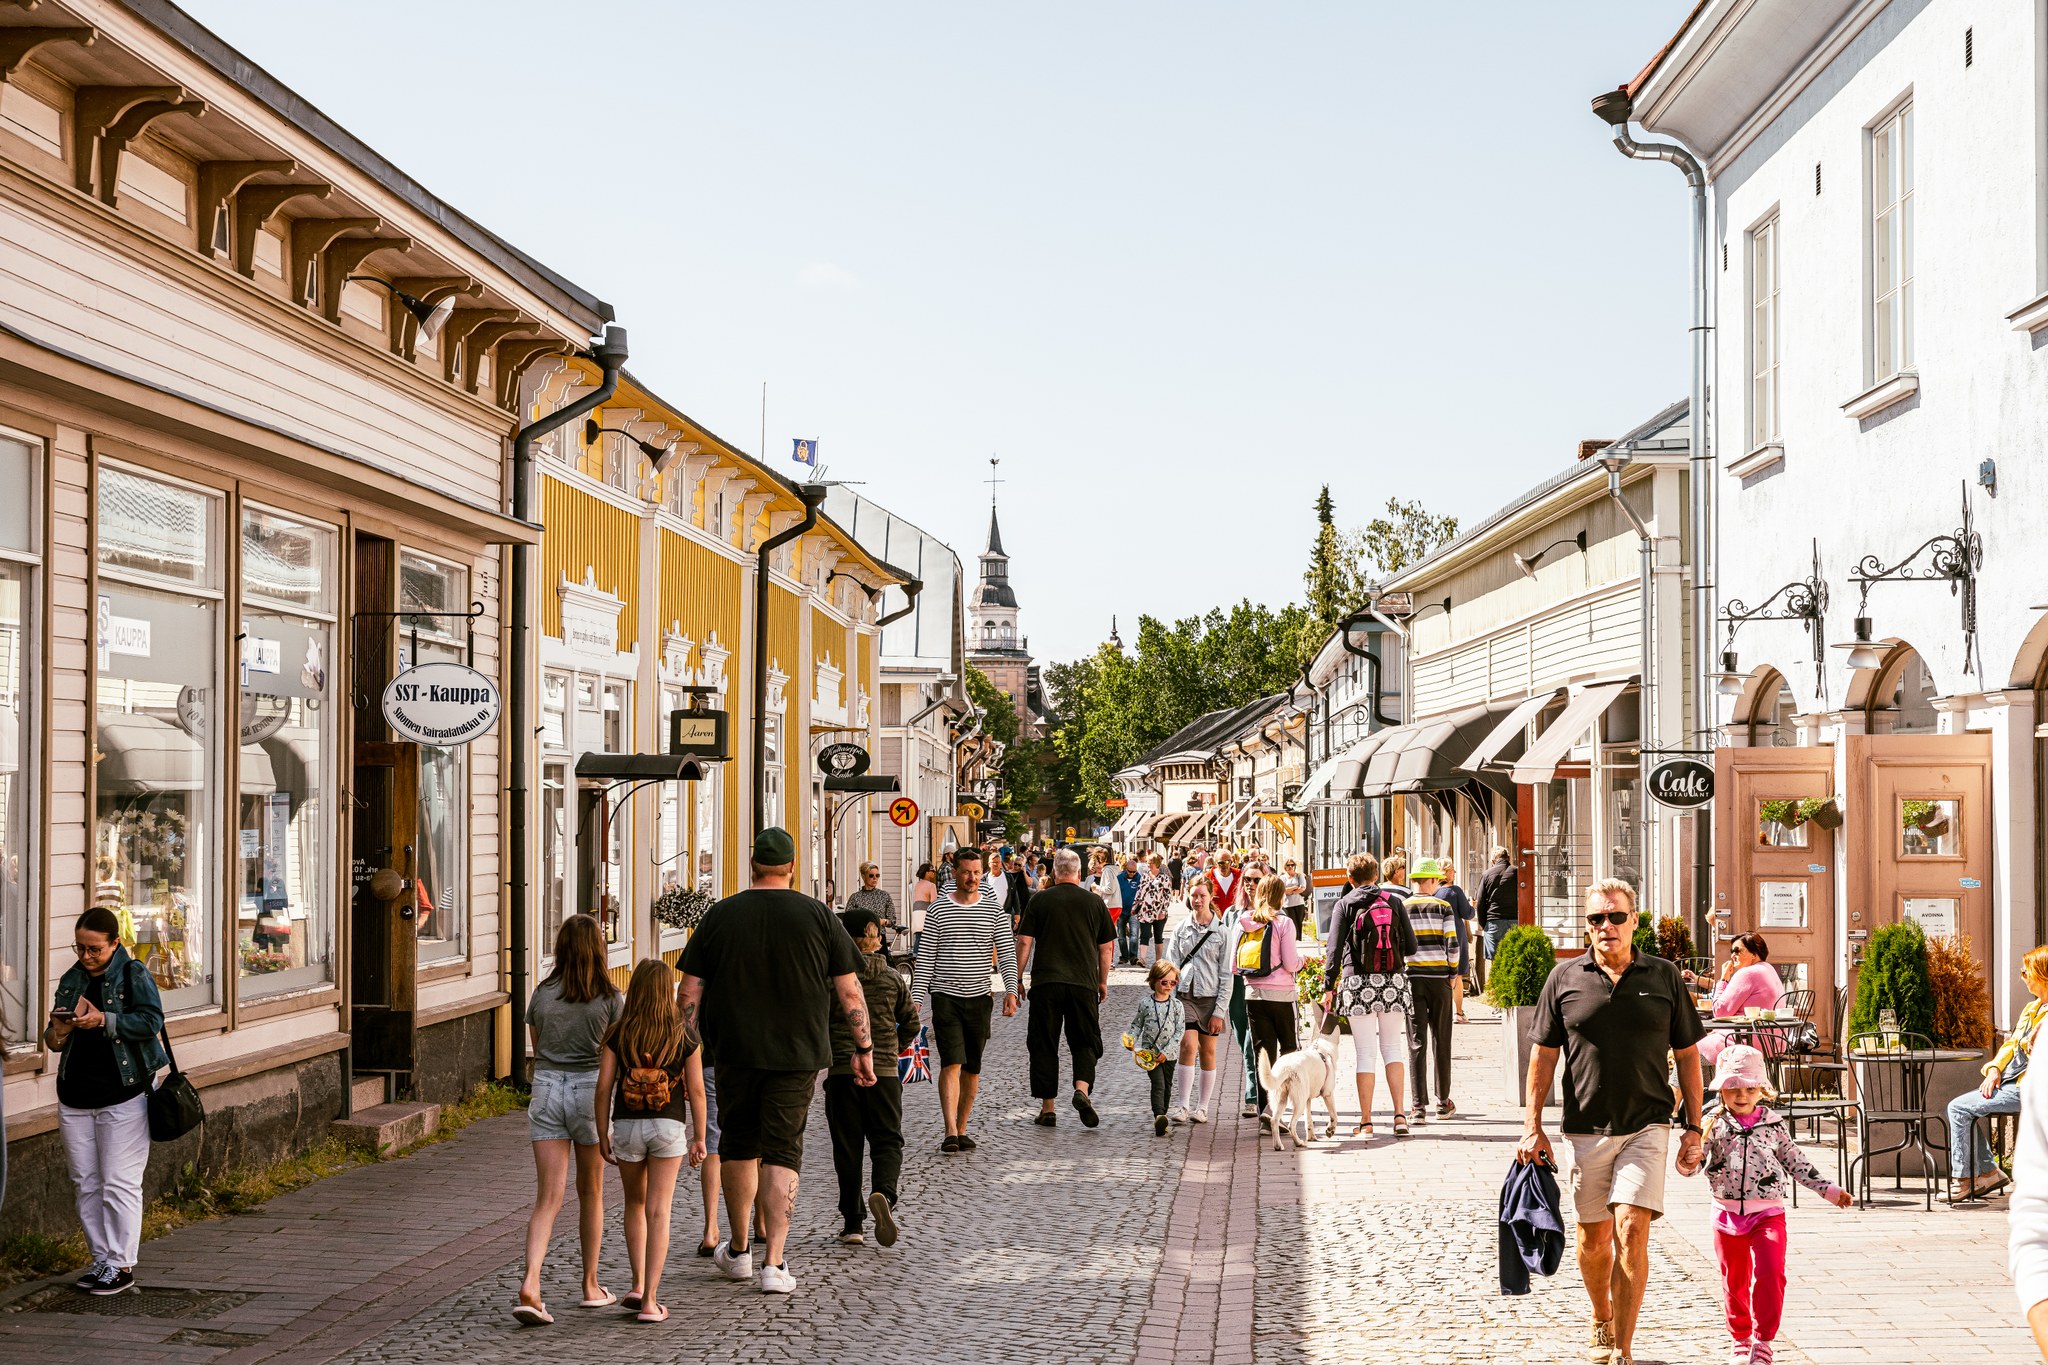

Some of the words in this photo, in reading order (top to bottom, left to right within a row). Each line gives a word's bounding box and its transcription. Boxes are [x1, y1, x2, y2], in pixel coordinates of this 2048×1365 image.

[115, 625, 148, 649] KAUPPA
[429, 685, 490, 705] Kauppa
[393, 706, 422, 734] Suomen
[421, 717, 481, 739] Sairaalatukku
[477, 707, 491, 721] Oy
[681, 724, 714, 738] Aaren
[1659, 769, 1709, 797] Cafe
